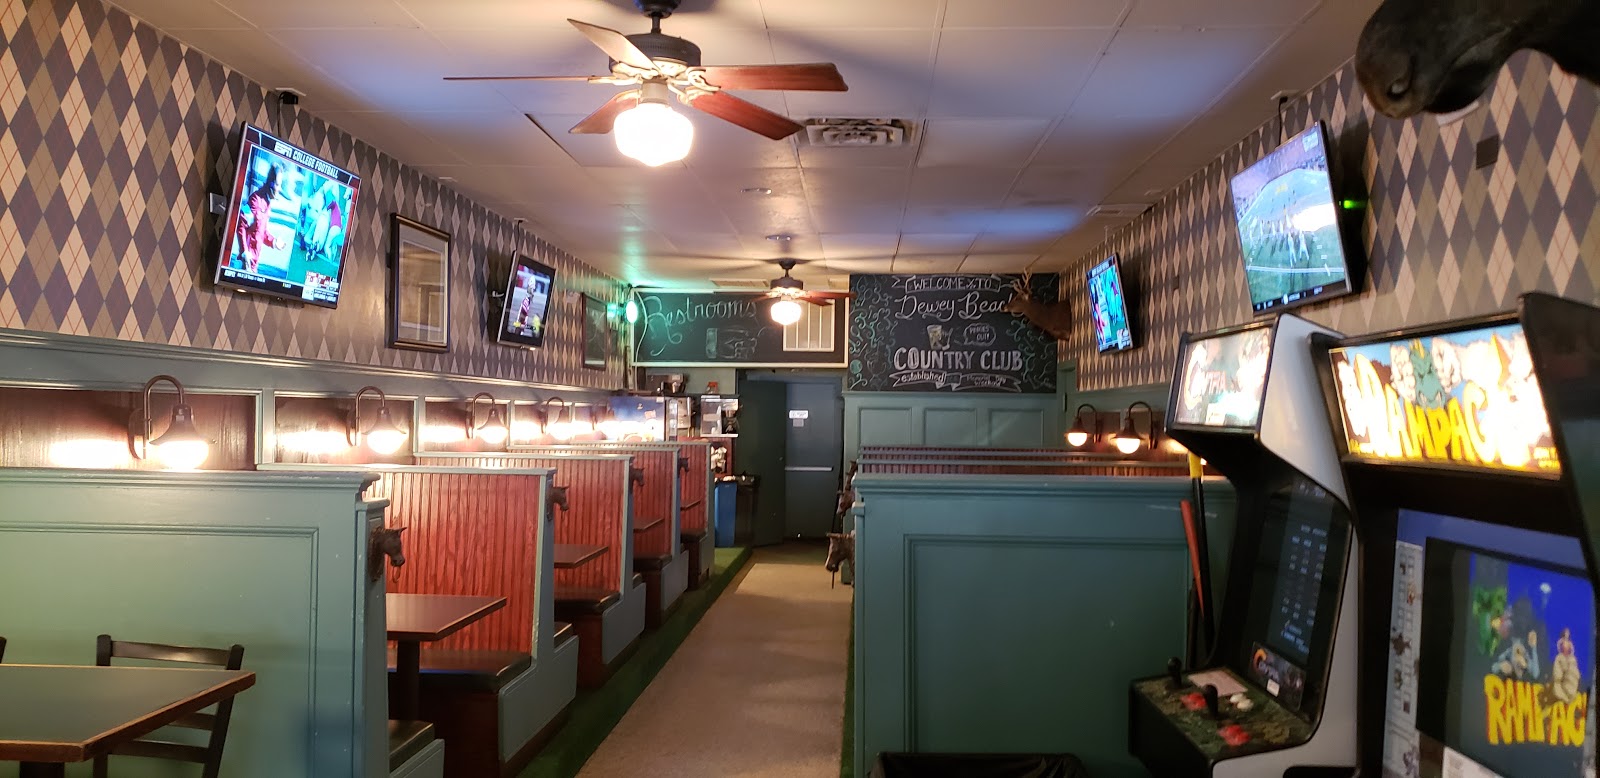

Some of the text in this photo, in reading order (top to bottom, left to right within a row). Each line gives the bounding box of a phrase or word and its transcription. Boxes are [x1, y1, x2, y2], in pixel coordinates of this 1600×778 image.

[274, 142, 339, 179] ESPN COLLEGE FOOTBALL
[913, 277, 991, 290] WELCOME TO
[642, 295, 757, 345] Restrooms
[894, 291, 1013, 322] Dewey Beac
[893, 347, 1023, 371] COUNTRY CLUB
[901, 371, 945, 383] established
[1184, 344, 1227, 410] CTRA
[1484, 673, 1587, 747] RAMPAG
